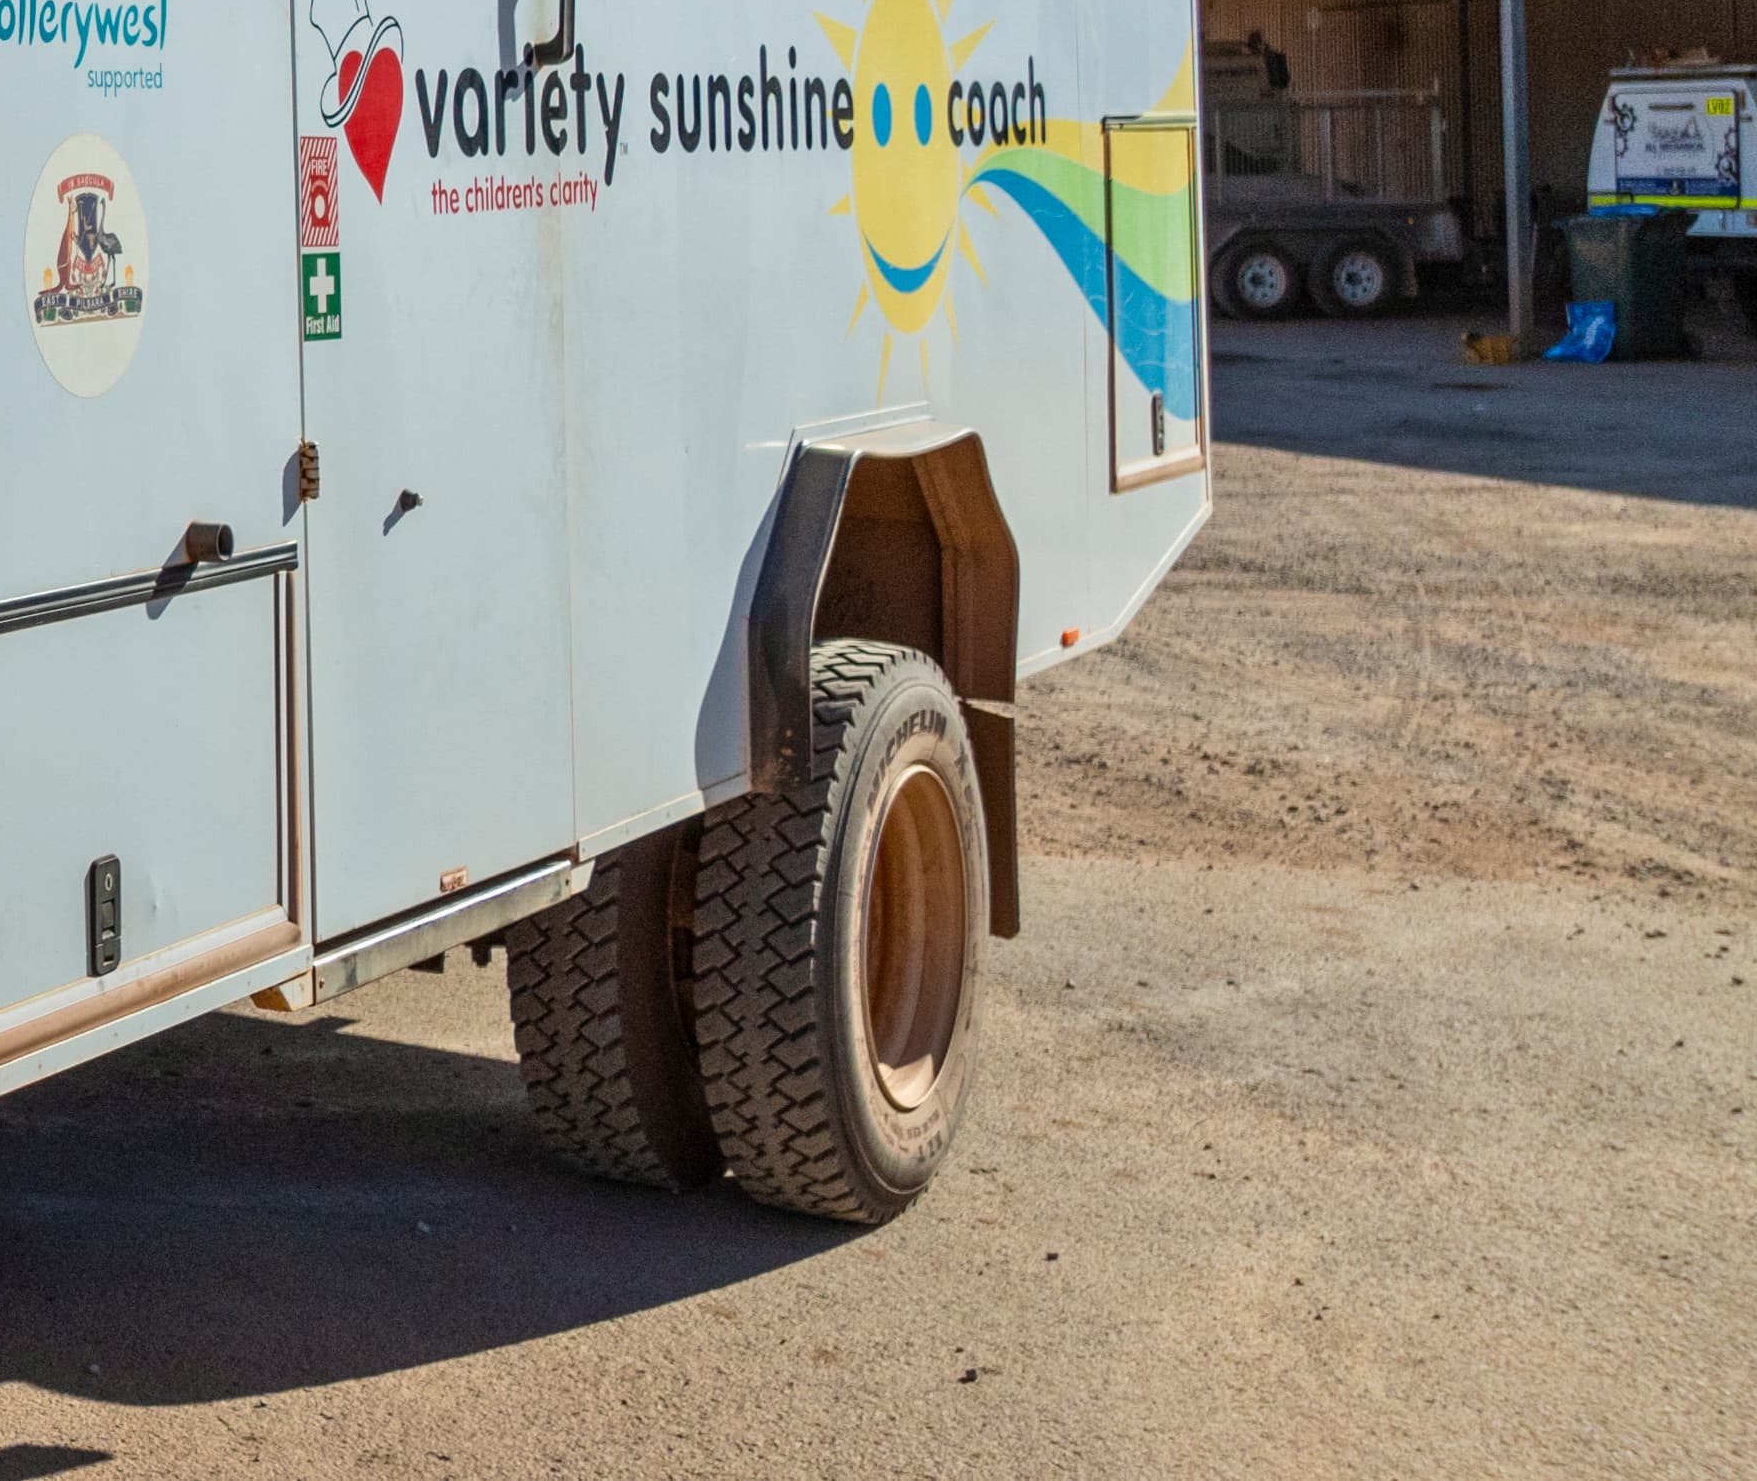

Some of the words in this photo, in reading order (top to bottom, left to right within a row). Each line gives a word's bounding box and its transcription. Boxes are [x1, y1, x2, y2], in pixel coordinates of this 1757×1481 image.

[87, 64, 163, 97] supported
[415, 42, 625, 186] variety
[649, 44, 854, 154] sunshine
[948, 55, 1047, 148] coach
[310, 159, 328, 176] FIRE
[431, 179, 460, 215] the
[465, 175, 544, 213] children's
[306, 317, 324, 334] First
[326, 314, 340, 332] Aid
